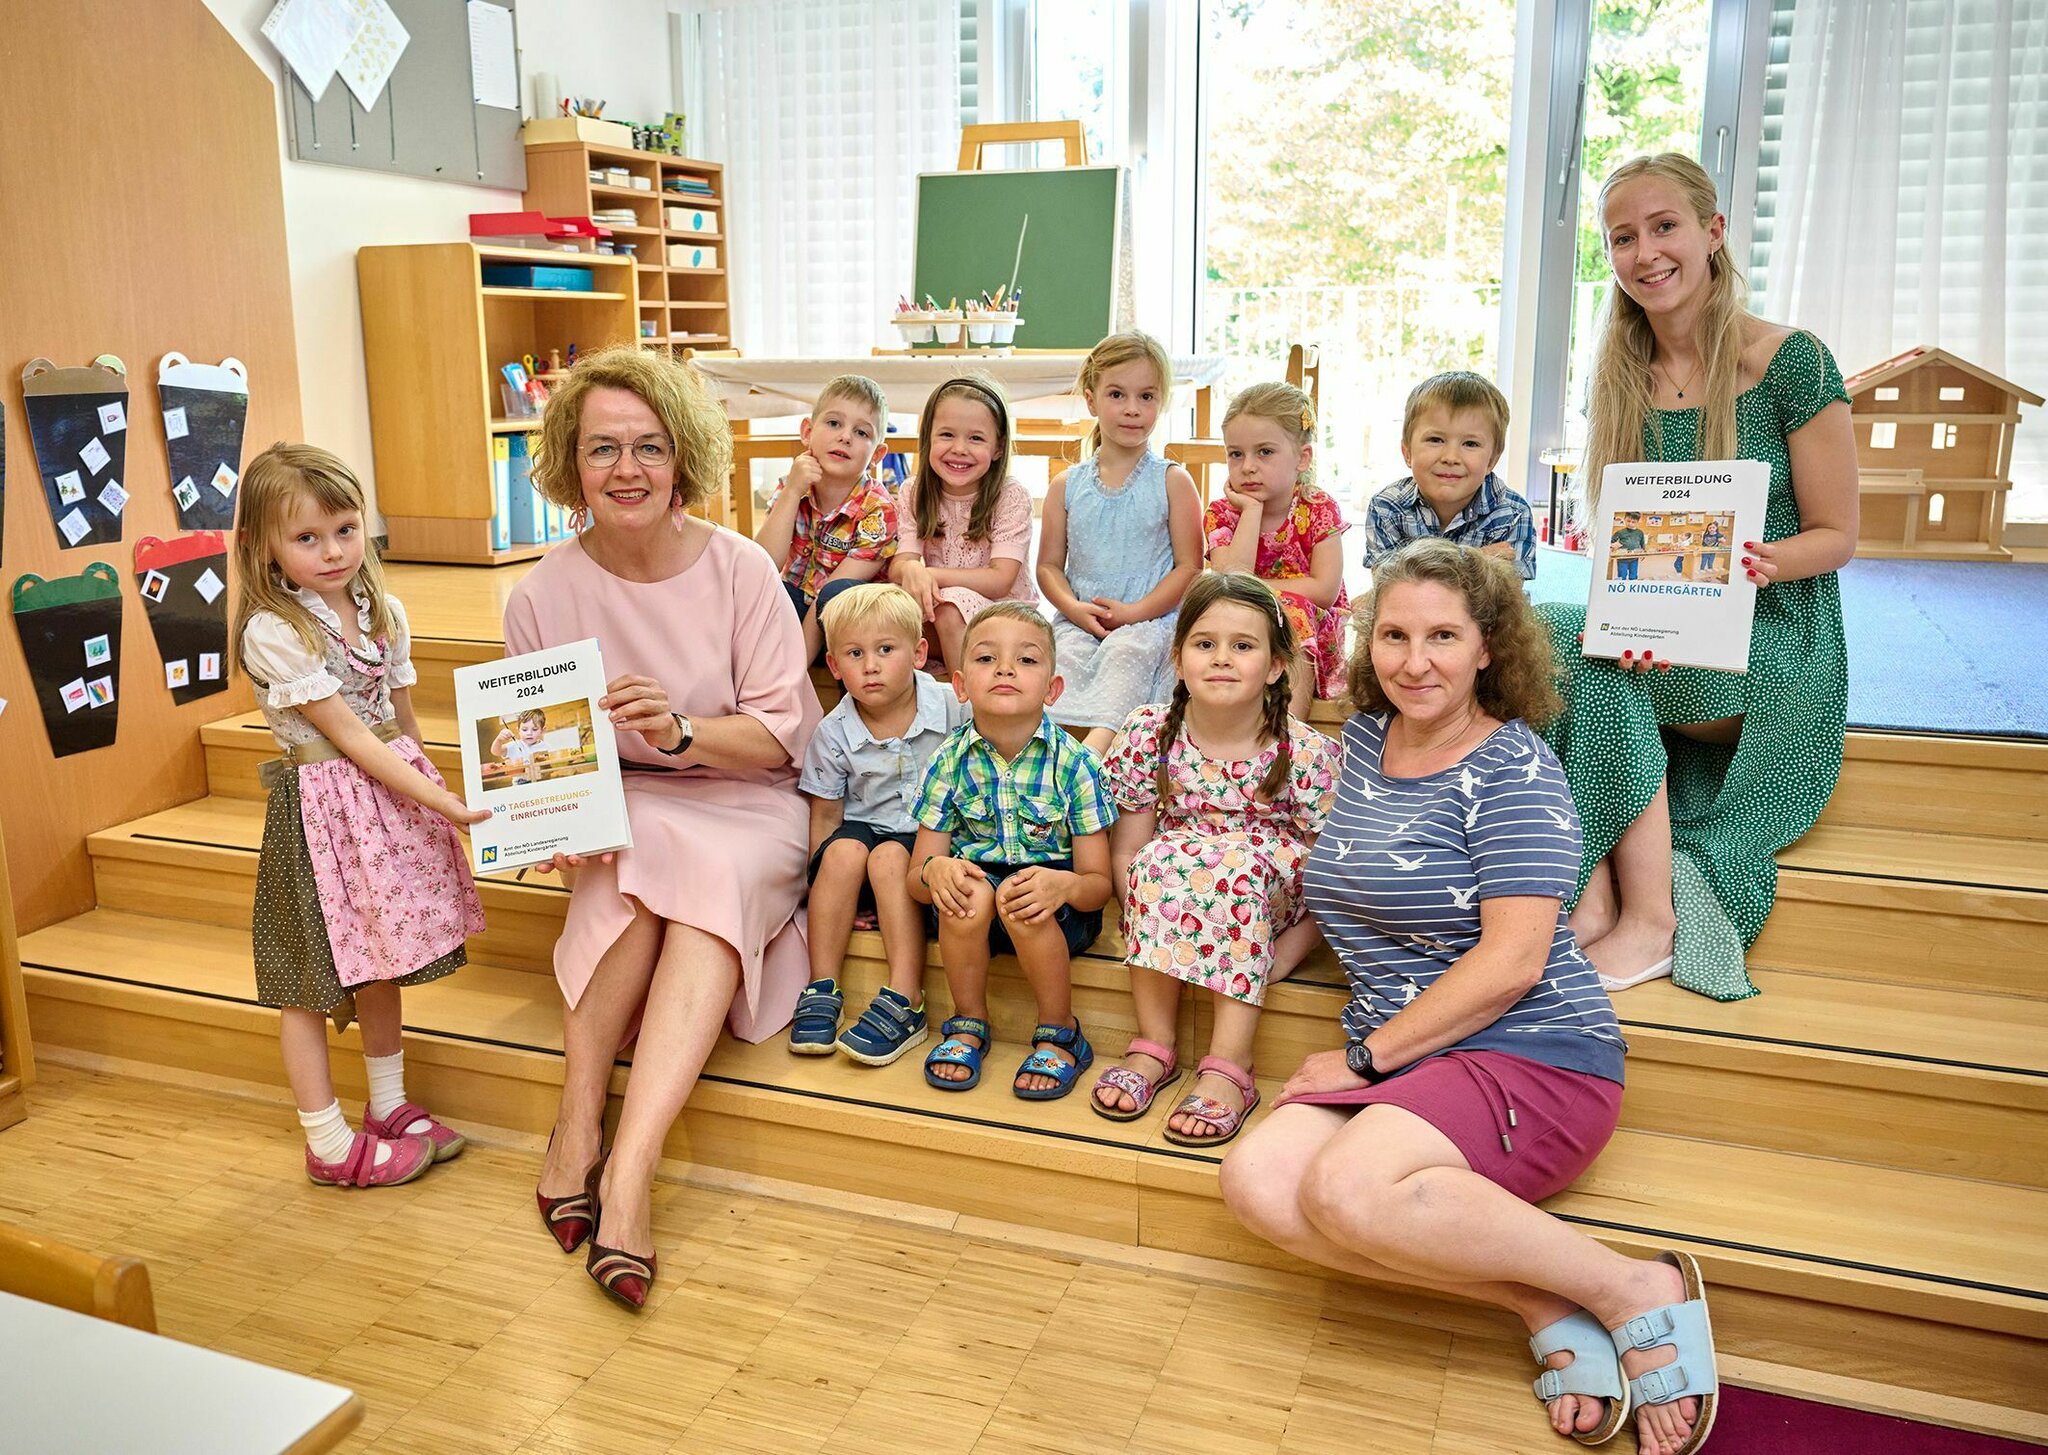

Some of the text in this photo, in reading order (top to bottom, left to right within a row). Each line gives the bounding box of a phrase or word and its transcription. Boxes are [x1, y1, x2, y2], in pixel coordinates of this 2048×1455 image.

[1625, 474, 1732, 485] WEITERBILDUNG
[1662, 489, 1690, 499] 2024
[1607, 583, 1722, 598] NÖ KINDERGÄRTEN
[478, 661, 577, 691] WEITERBILDUNG
[516, 684, 545, 698] 2024
[493, 788, 593, 814] NÖ TAGESBETREUUNGS-
[510, 802, 579, 822] EINRICHTUNGEN
